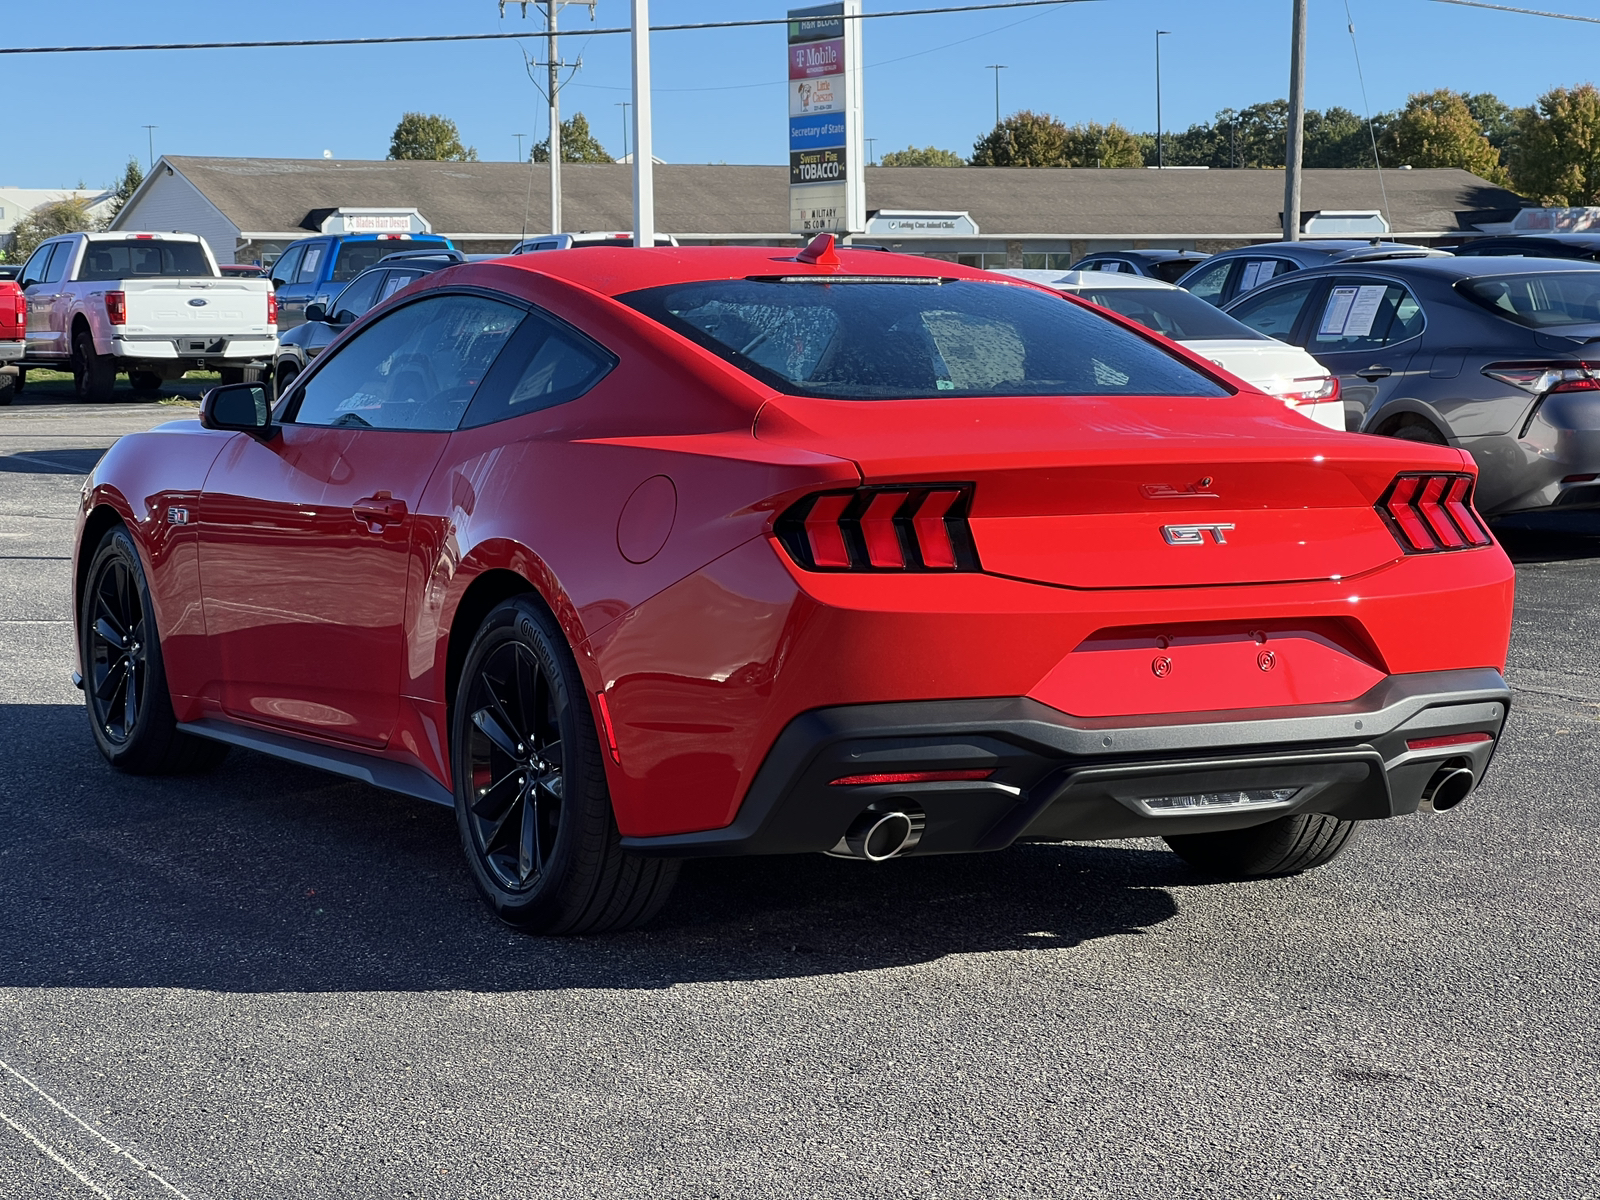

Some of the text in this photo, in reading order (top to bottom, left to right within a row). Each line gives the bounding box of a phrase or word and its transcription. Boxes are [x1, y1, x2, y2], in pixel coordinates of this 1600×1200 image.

[806, 46, 837, 66] Mobile
[816, 80, 831, 91] Little
[791, 123, 845, 138] Secretary of State
[800, 153, 821, 164] SWEET
[825, 151, 838, 162] FIRE
[799, 162, 839, 180] TOBACCO
[811, 208, 837, 218] MILITARY
[375, 216, 388, 228] Hair
[389, 216, 408, 230] Design
[1159, 523, 1236, 546] GT
[520, 617, 560, 681] Continental
